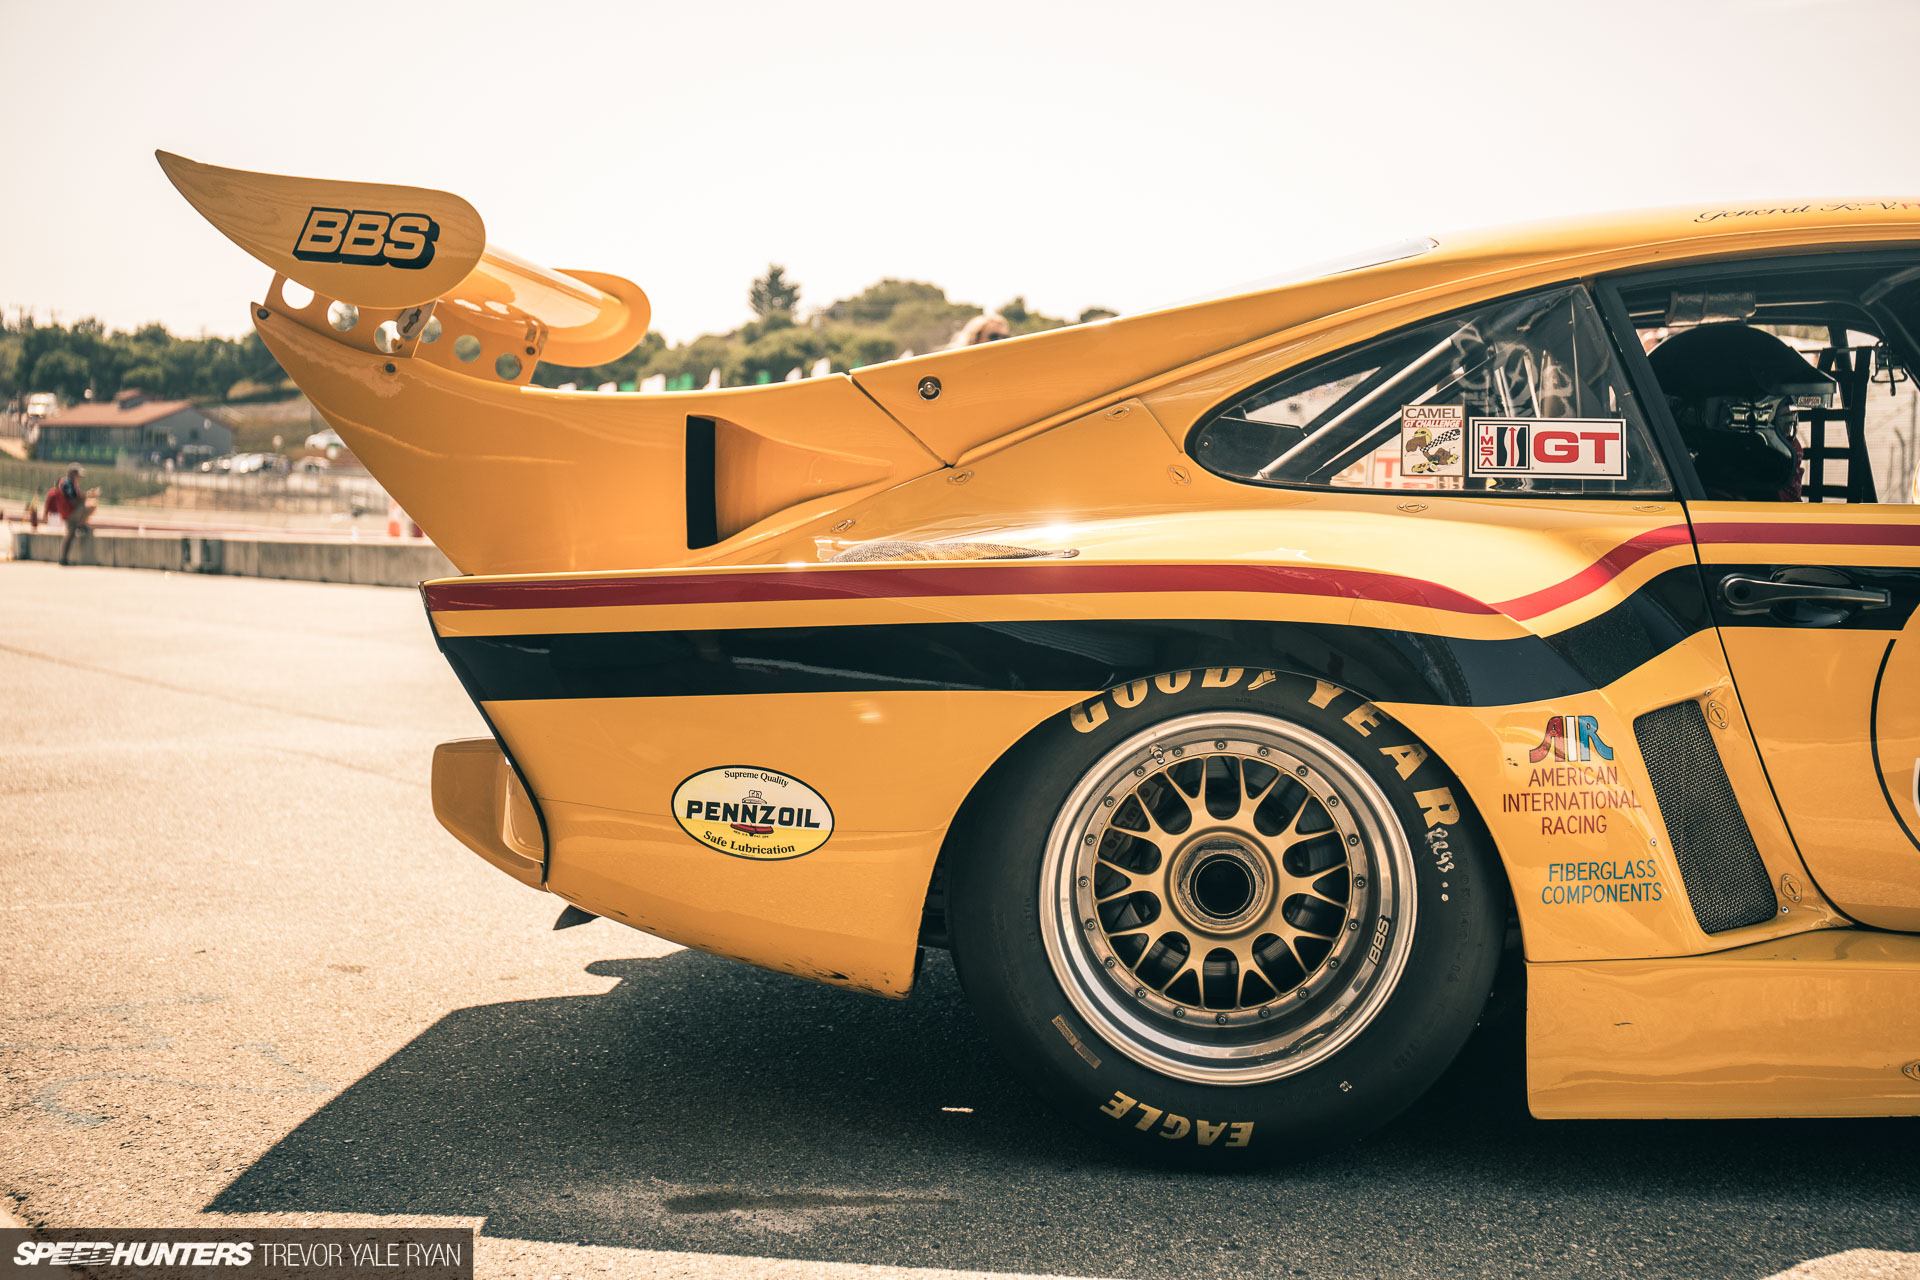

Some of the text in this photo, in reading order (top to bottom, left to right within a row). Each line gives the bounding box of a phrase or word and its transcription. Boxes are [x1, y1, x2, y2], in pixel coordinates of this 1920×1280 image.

[292, 206, 440, 270] BBS
[1405, 408, 1461, 419] CAMEL
[1415, 420, 1461, 428] CHALLENGE
[1481, 426, 1494, 467] IMSA
[1533, 431, 1620, 464] GT
[1529, 716, 1614, 763] AIR
[724, 770, 789, 787] Supreme Quality
[1528, 766, 1618, 787] AMERICAN
[1503, 790, 1642, 812] INTERNATIONAL
[686, 800, 820, 829] PENNZOIL
[1541, 815, 1607, 835] RACING
[703, 830, 727, 847] Safe
[730, 840, 796, 855] Lubrication
[1549, 860, 1656, 882] FIBERGLASS
[1541, 882, 1662, 904] COMPONENTS
[1368, 915, 1391, 966] BBS
[1099, 1090, 1255, 1147] EAGLE
